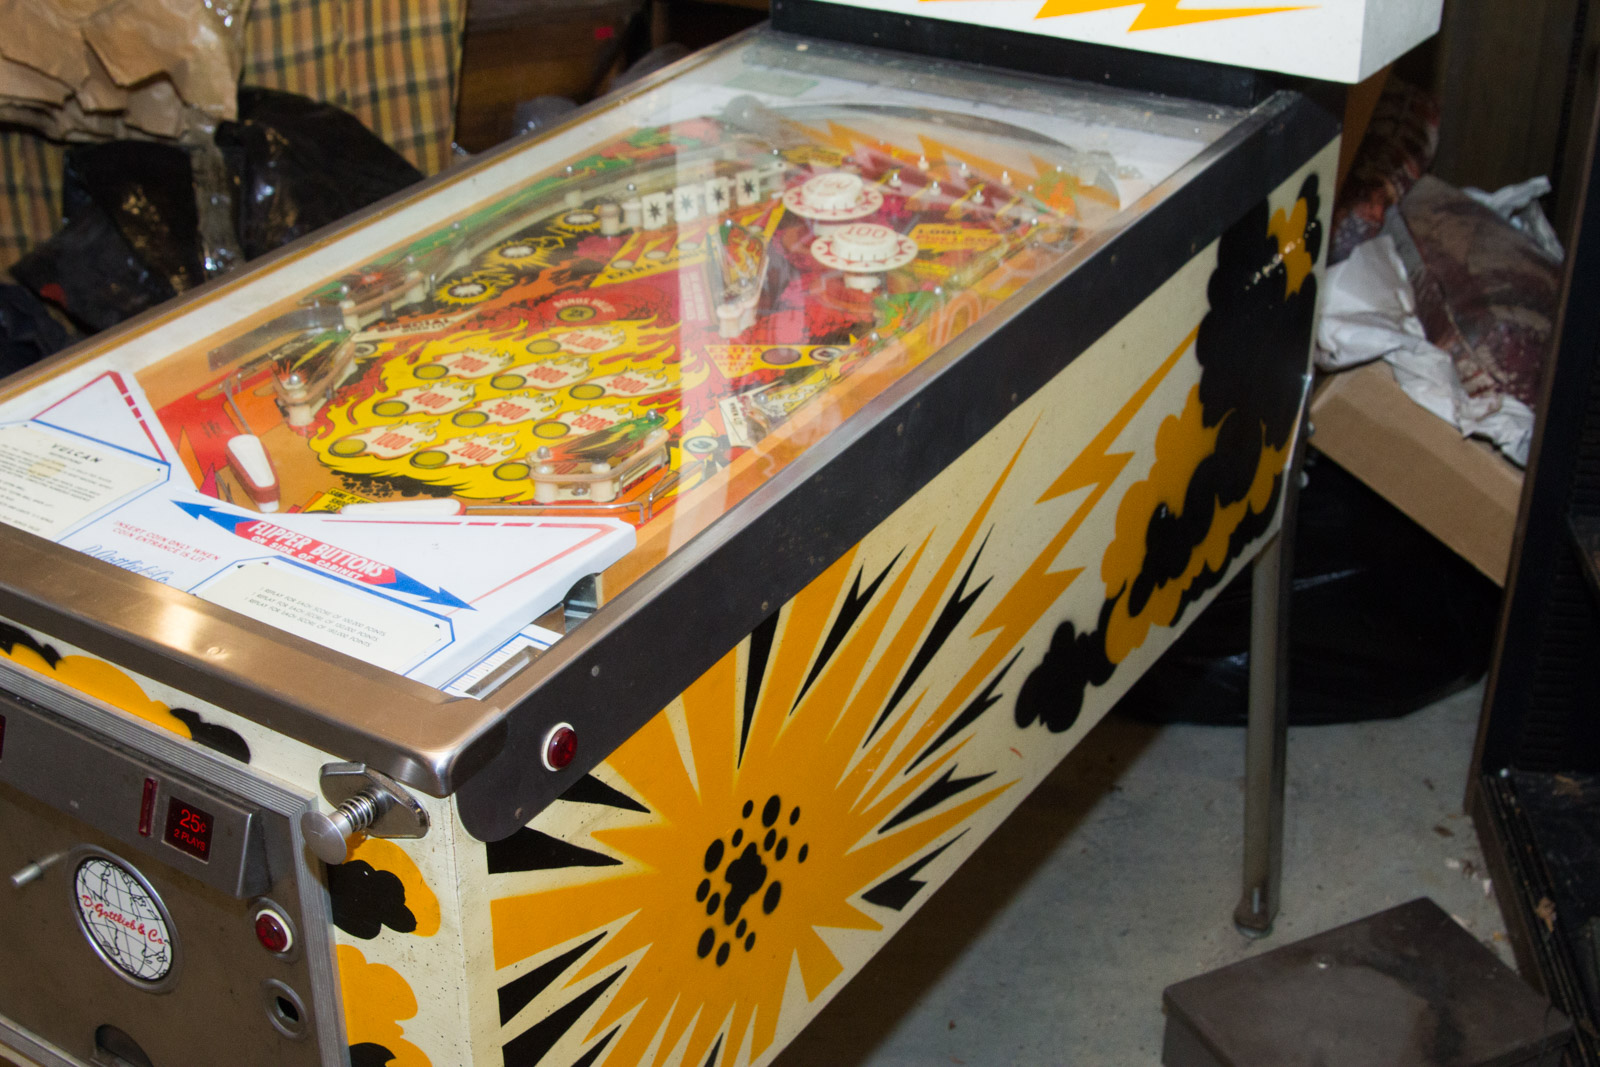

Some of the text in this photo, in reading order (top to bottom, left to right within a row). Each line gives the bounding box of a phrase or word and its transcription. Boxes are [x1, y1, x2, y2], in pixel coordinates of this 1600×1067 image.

[846, 225, 888, 239] 100
[448, 354, 490, 373] 7000
[526, 365, 569, 384] 8000
[606, 376, 649, 394] 9000
[412, 391, 453, 410] 4000
[488, 401, 531, 420] 5000
[371, 432, 414, 450] 1000
[51, 443, 103, 463] VULCAN
[451, 442, 498, 462] 2000
[112, 527, 207, 563] COIN ENTRANCE IS LIT
[114, 520, 220, 561] INSERT COIN ONLY WHEN
[248, 521, 390, 577] FLIPPER BUTTONS
[251, 535, 363, 580] ON SIDE OF CABINET
[180, 808, 206, 833] 25¢
[173, 828, 206, 852] 2 PLAYS
[95, 903, 136, 931] Gottlieb
[137, 922, 146, 936] &
